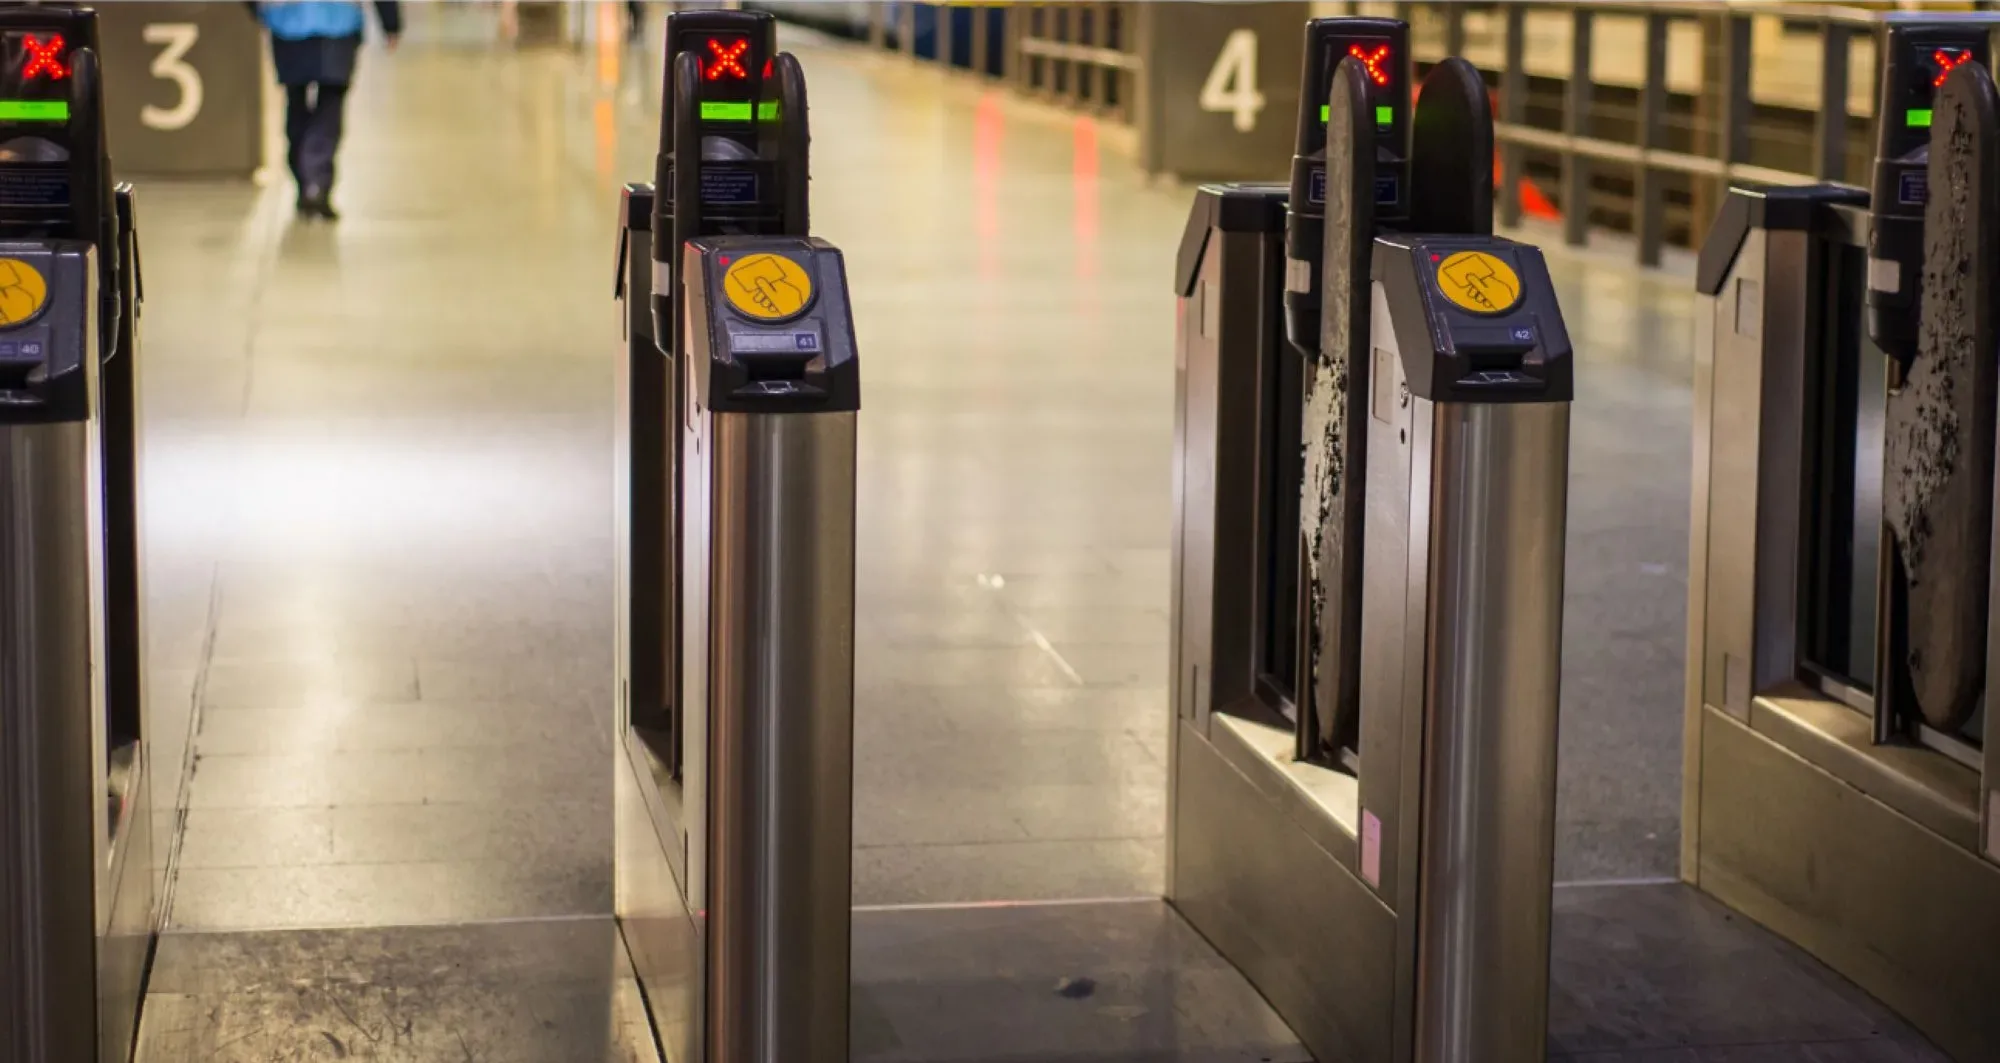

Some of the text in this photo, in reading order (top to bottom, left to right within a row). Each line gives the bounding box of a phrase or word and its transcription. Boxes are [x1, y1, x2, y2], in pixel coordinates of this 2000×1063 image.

[141, 23, 204, 130] 3
[1200, 28, 1266, 132] 4
[1515, 330, 1530, 340] 42
[799, 336, 814, 347] 41
[22, 343, 40, 354] 40
